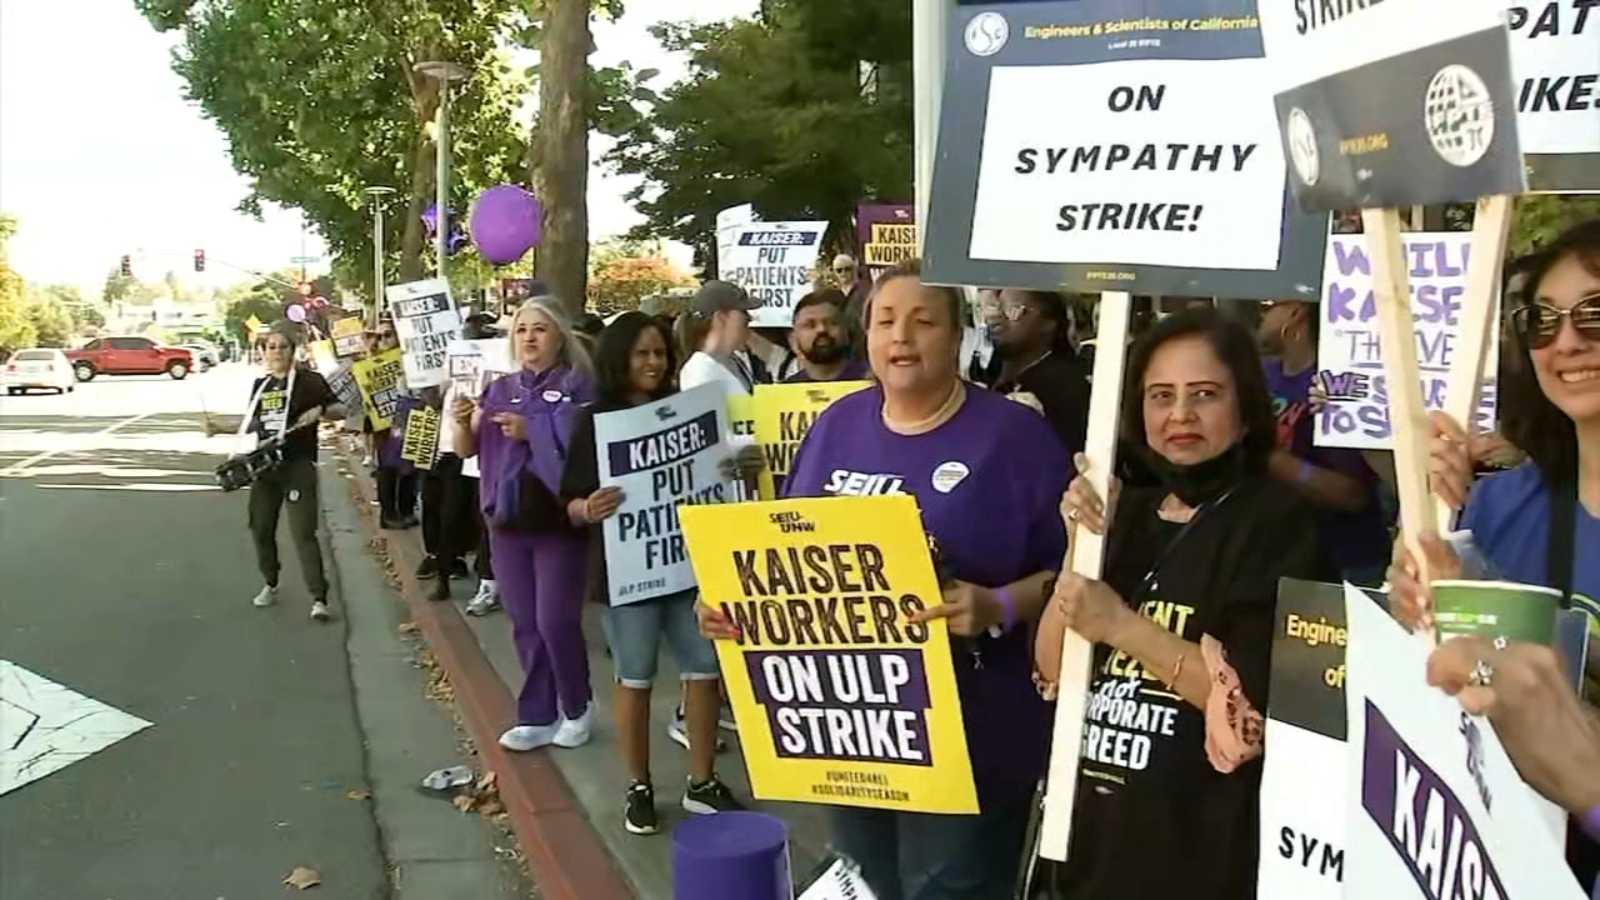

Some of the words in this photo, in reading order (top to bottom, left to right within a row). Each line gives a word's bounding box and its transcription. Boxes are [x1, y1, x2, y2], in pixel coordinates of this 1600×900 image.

[1024, 23, 1089, 39] Engineers
[1104, 17, 1169, 34] Scientists
[1171, 18, 1187, 30] of
[1189, 15, 1257, 30] California
[1295, 0, 1385, 35] STRI
[1108, 84, 1165, 113] ON
[1519, 74, 1600, 112] IKE
[1014, 142, 1257, 175] SYMPATHY
[1055, 203, 1202, 233] STRIKE!
[750, 232, 806, 245] KAISER:
[759, 247, 789, 264] PUT
[735, 265, 808, 286] PATIENTS
[750, 288, 793, 308] FIRST
[1320, 369, 1370, 401] WE
[1321, 403, 1358, 437] TO
[629, 421, 707, 471] KAISER:
[652, 458, 694, 503] PUT
[732, 543, 890, 597] KAISER
[719, 593, 930, 647] WORKERS
[1287, 613, 1347, 647] Engine
[761, 653, 825, 705] ON
[826, 653, 910, 705] ULP
[1086, 690, 1180, 737] RPORATE
[776, 706, 924, 761] STRIKE
[1083, 723, 1151, 771] REED
[1392, 748, 1501, 900] KAIS
